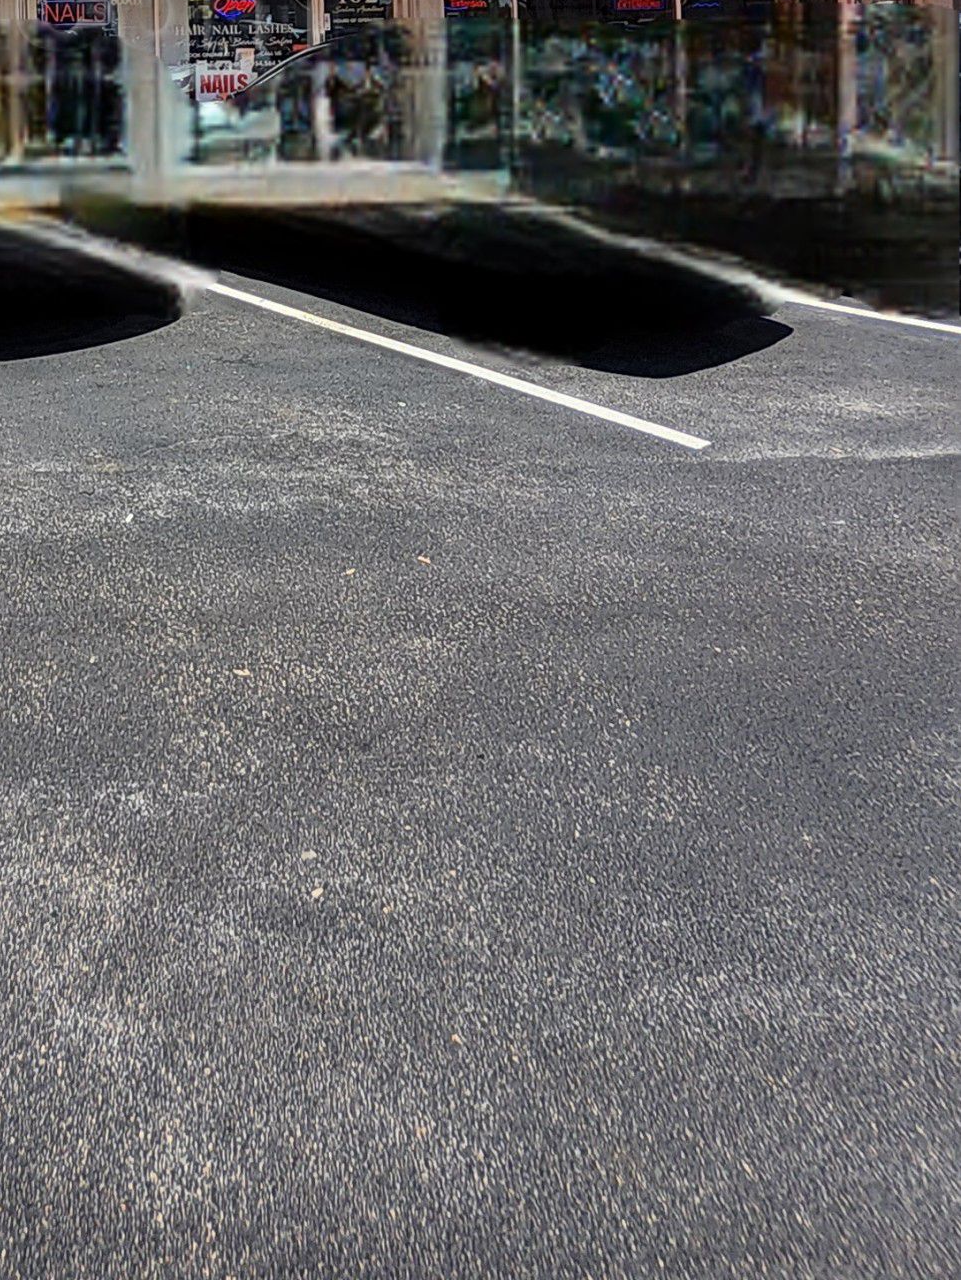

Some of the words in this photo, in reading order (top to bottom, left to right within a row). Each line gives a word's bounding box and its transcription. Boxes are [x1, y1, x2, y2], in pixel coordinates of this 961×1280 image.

[44, 2, 107, 23] NAILS
[174, 25, 206, 36] HAIR
[212, 24, 242, 35] NAIL
[248, 22, 294, 34] LASHES
[200, 73, 249, 94] NAILS
